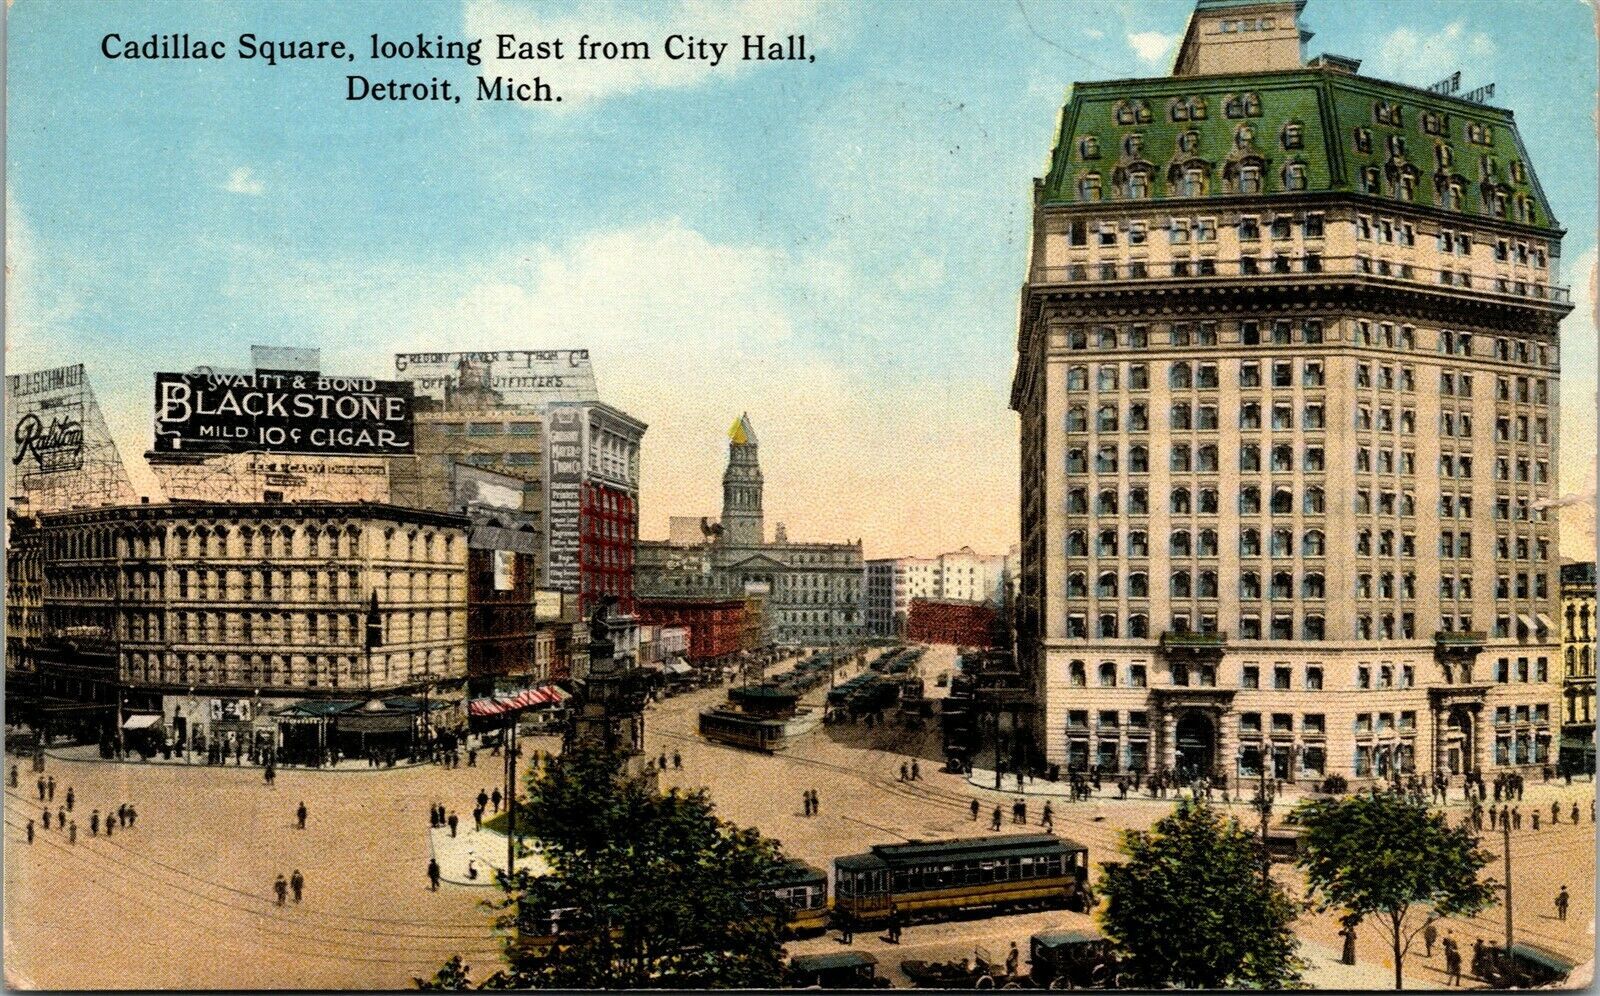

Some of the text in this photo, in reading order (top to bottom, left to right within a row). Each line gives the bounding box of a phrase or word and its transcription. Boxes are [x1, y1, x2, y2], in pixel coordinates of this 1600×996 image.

[215, 373, 377, 393] WAITT & BOND
[162, 381, 406, 423] BLACKSTONE
[199, 425, 249, 438] MILD
[310, 428, 410, 447] CIGAR
